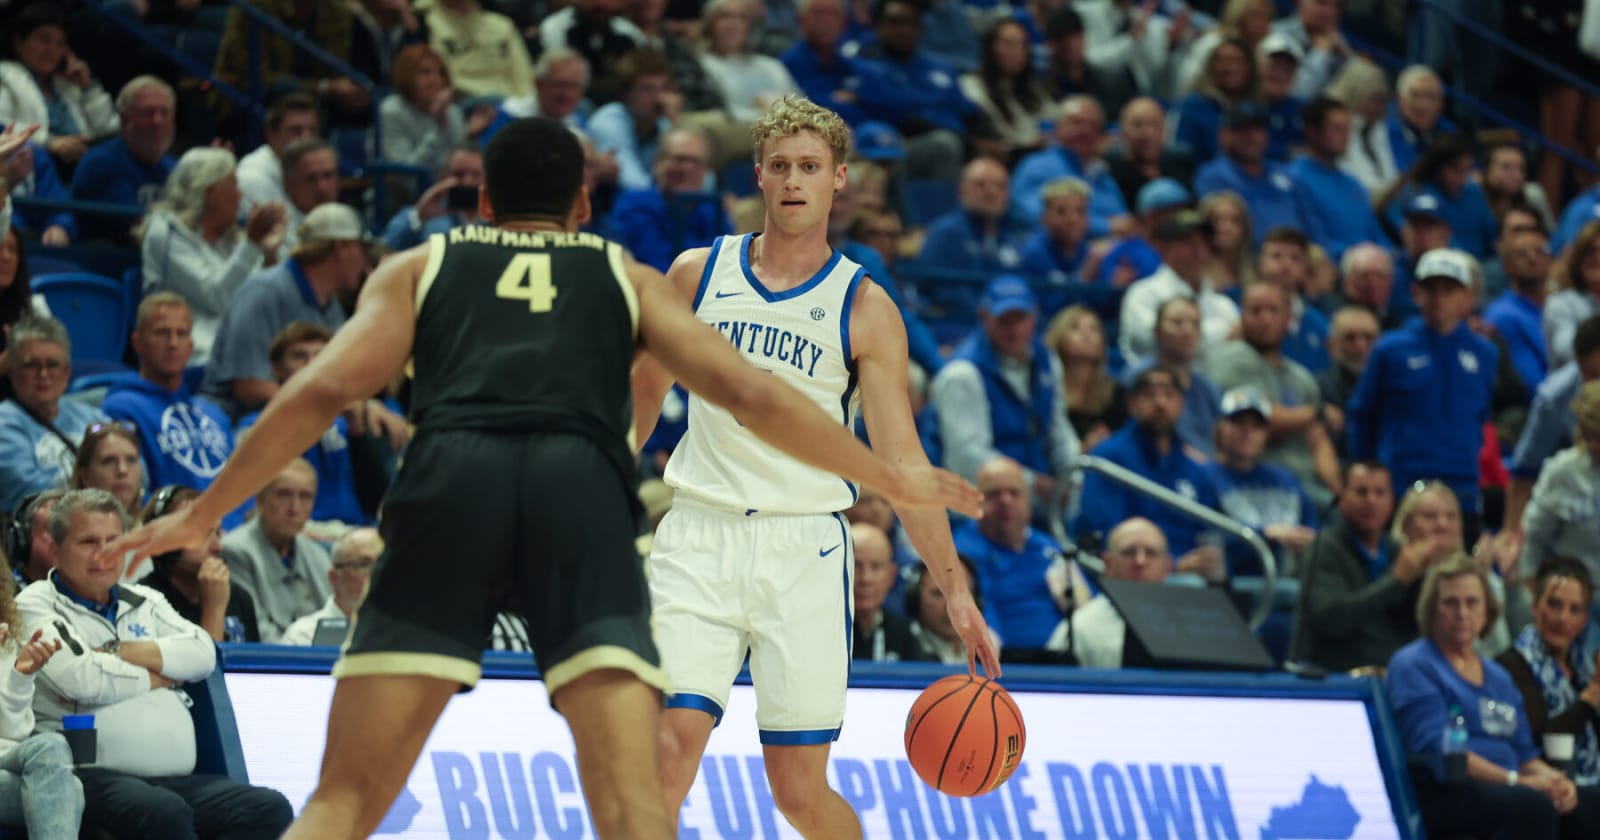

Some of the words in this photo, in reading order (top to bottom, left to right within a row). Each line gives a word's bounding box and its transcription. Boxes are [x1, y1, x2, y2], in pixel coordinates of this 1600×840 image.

[496, 252, 557, 313] 4
[710, 321, 823, 377] NTUCKY
[1046, 762, 1239, 840] DOWN
